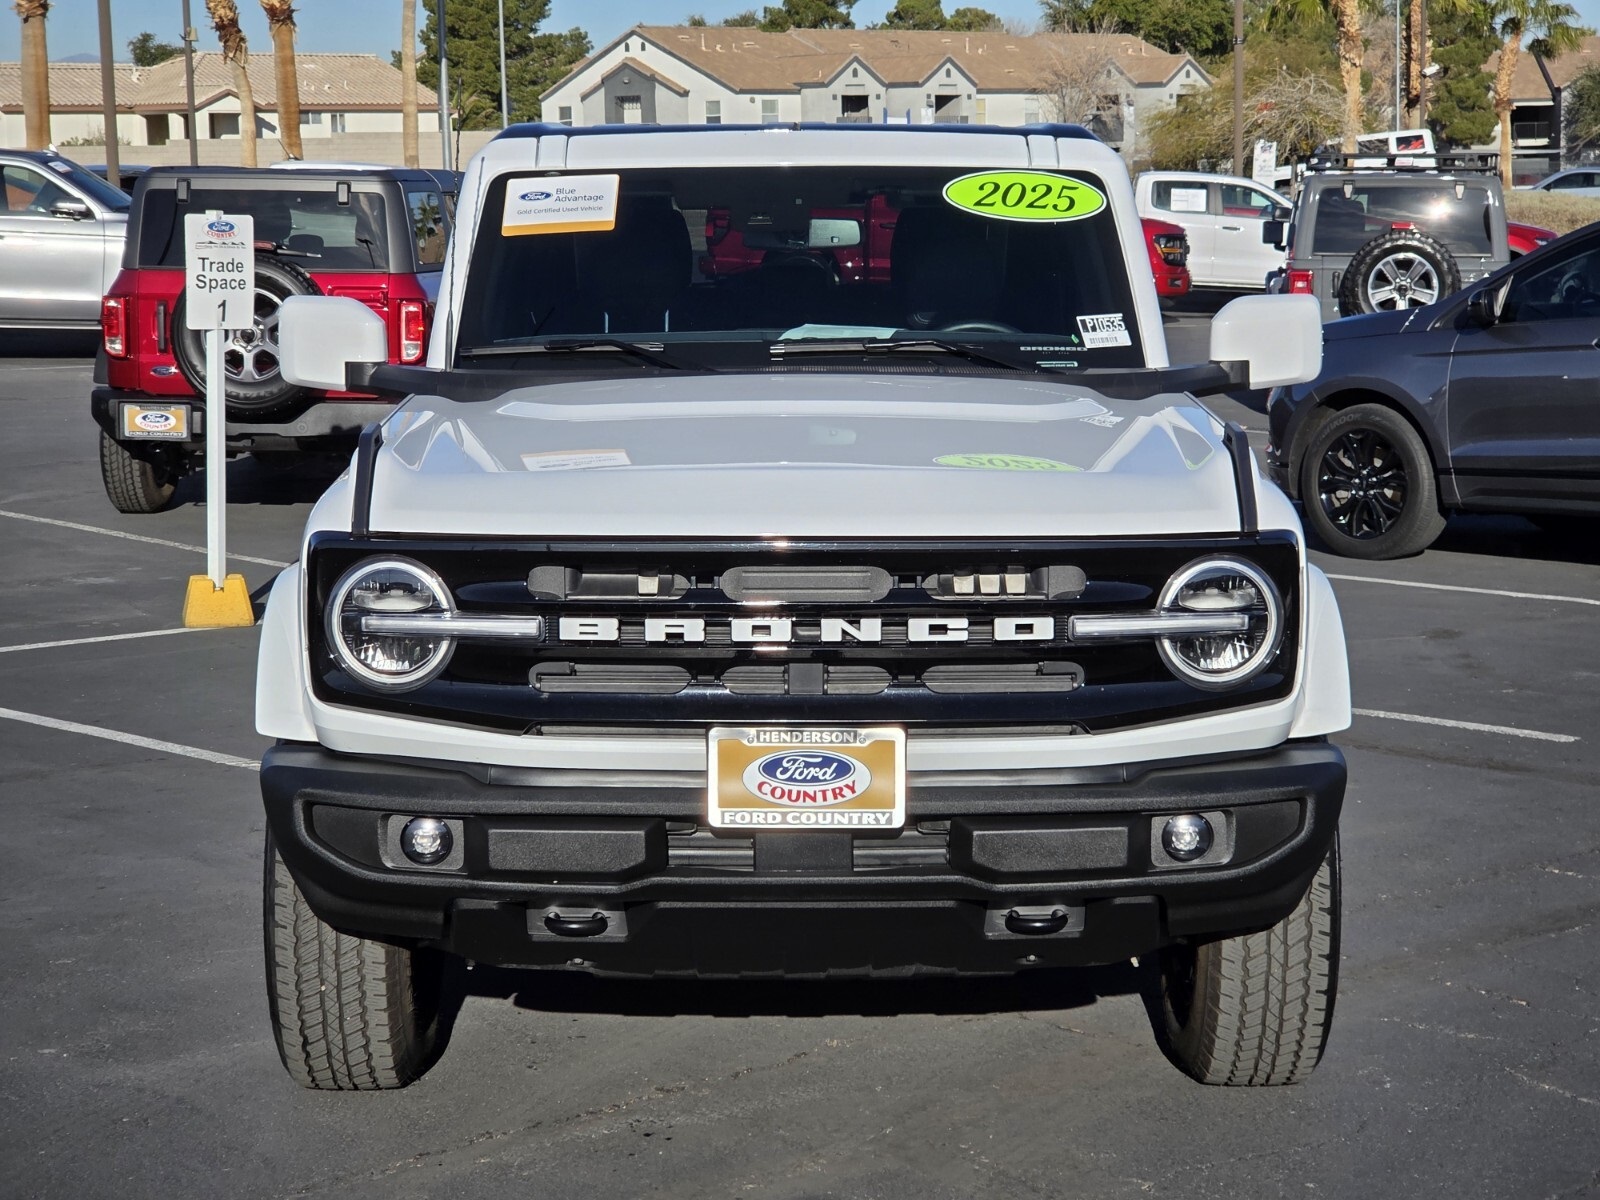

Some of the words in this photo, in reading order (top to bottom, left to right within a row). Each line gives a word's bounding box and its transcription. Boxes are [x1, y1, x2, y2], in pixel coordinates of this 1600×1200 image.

[973, 182, 1079, 212] 2025
[198, 257, 244, 273] Trade
[195, 274, 246, 293] Space
[217, 300, 227, 322] 1
[1086, 317, 1126, 332] P10535
[559, 616, 1054, 642] BRONCO
[759, 731, 854, 743] HENDERSON
[776, 756, 838, 781] Ford
[757, 780, 857, 803] COUNTRY
[724, 812, 782, 825] FORD
[786, 812, 892, 825] COUNTRY
